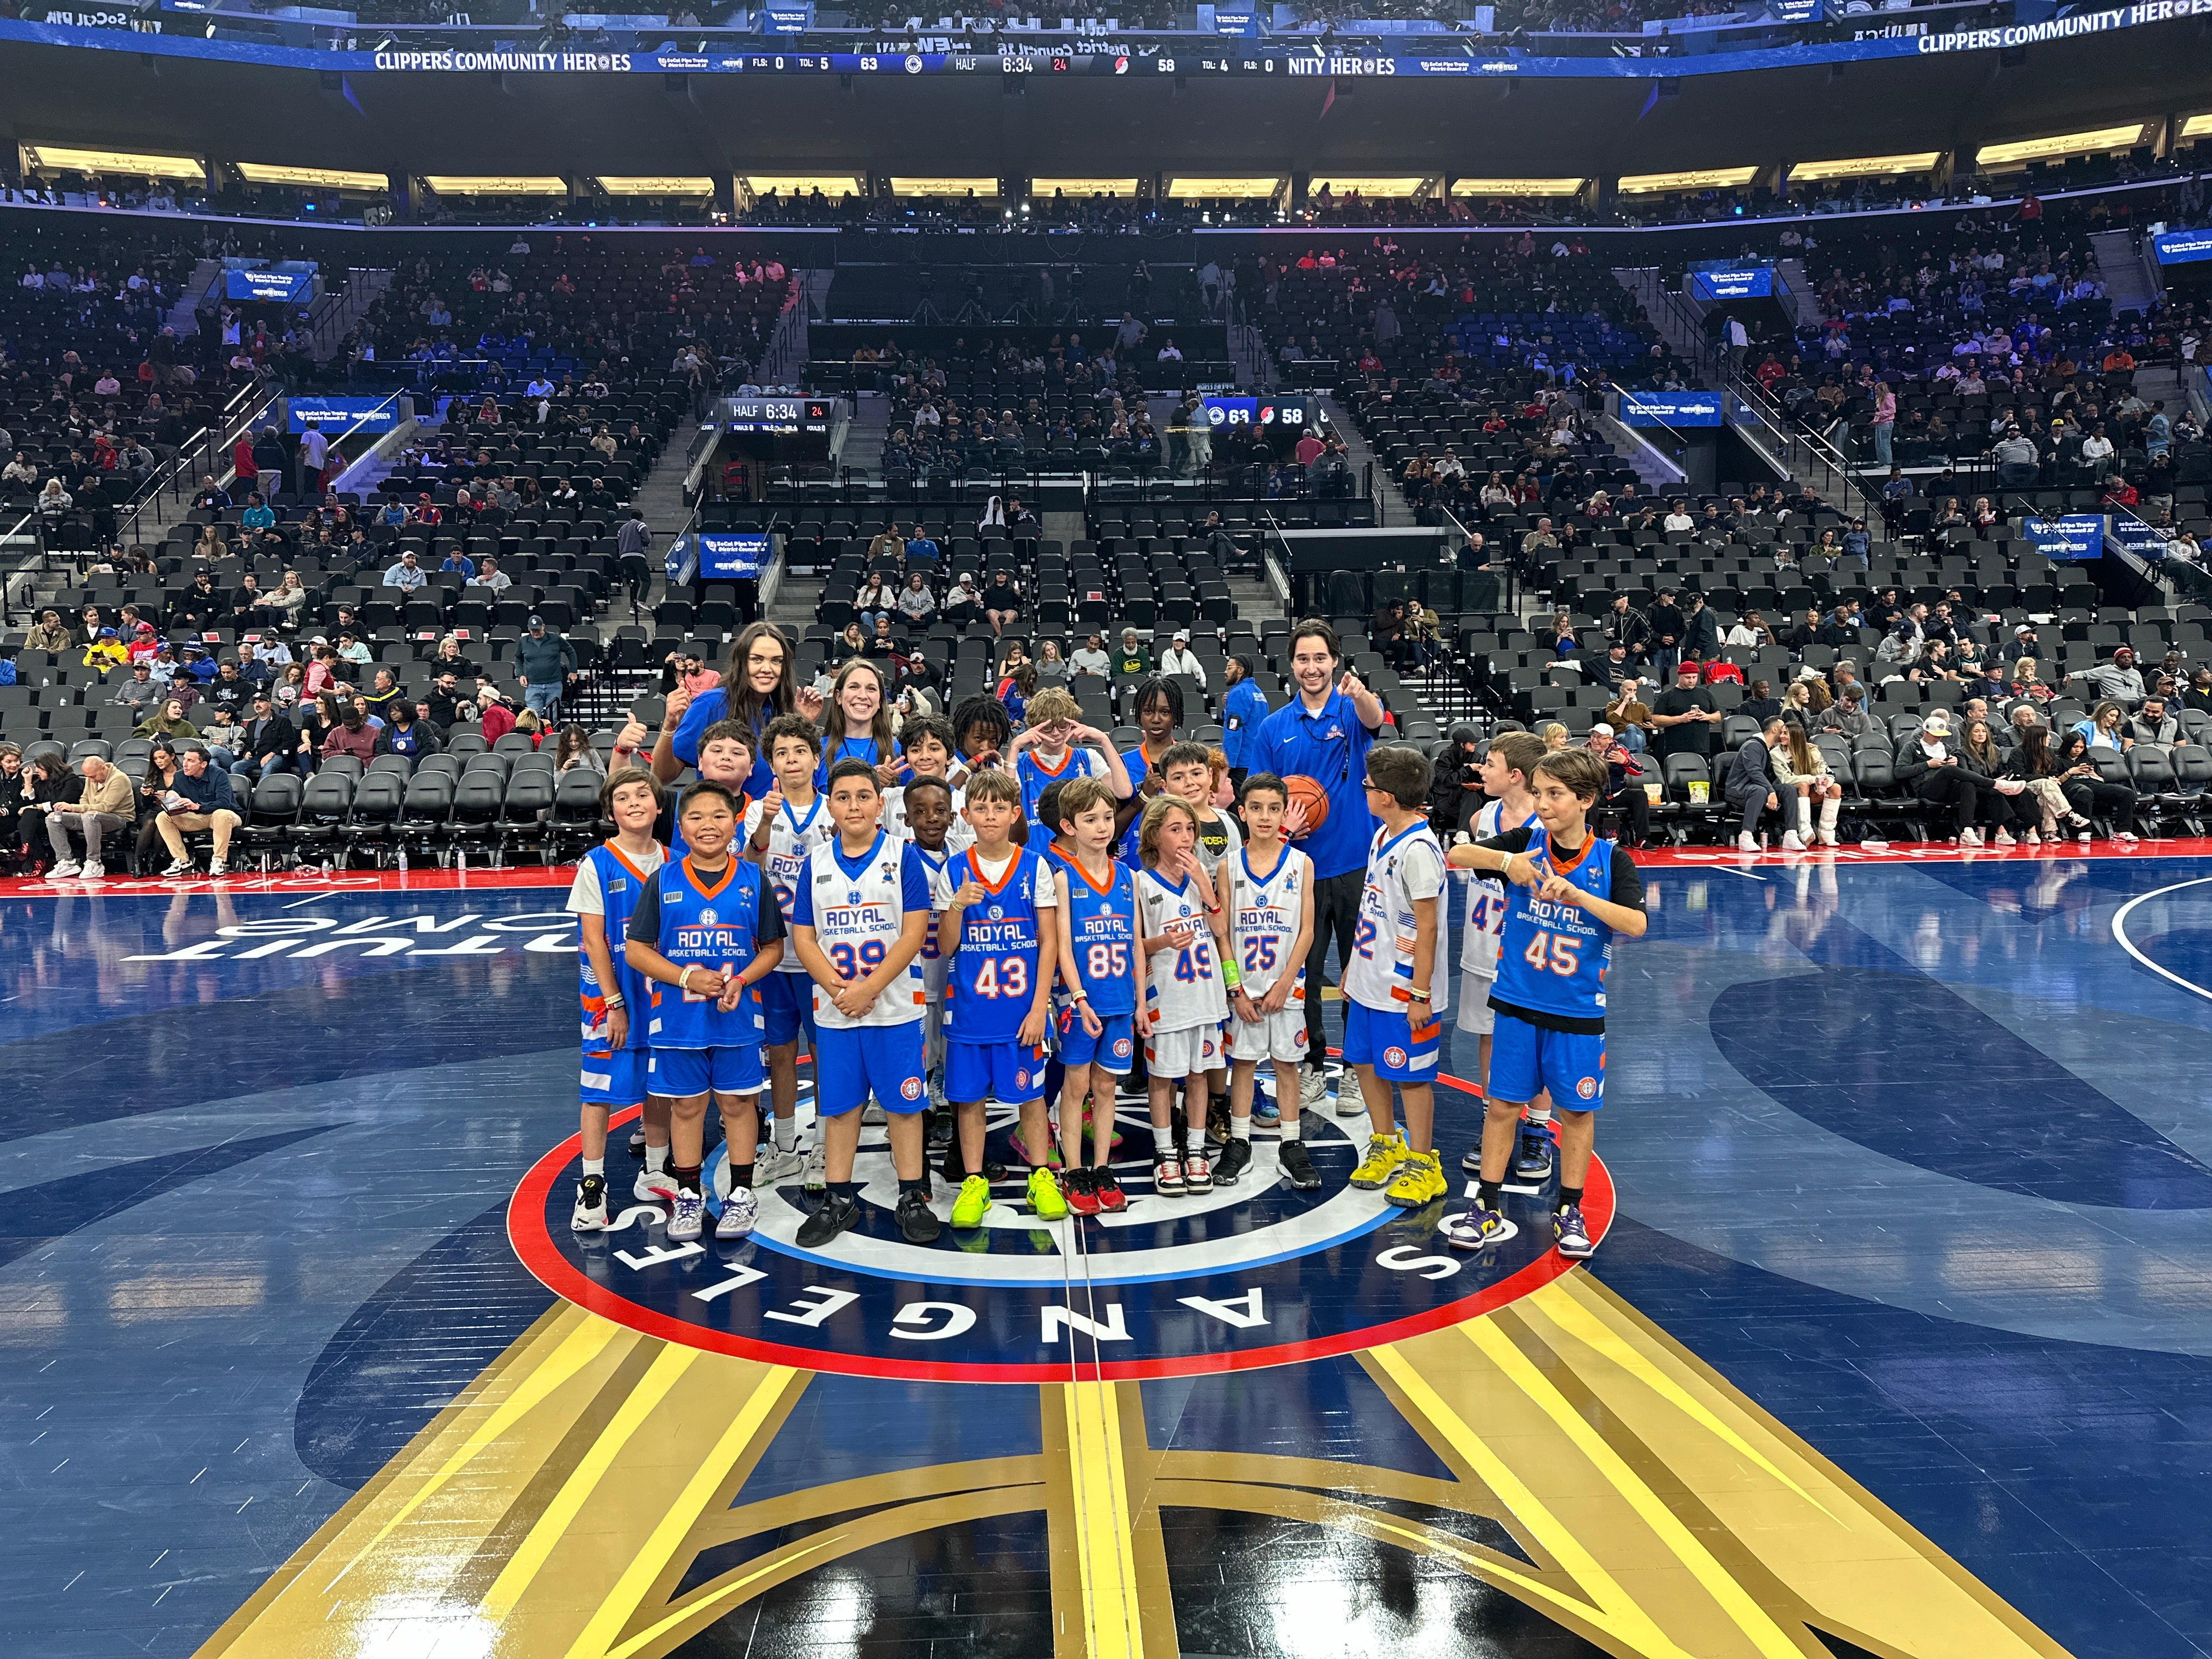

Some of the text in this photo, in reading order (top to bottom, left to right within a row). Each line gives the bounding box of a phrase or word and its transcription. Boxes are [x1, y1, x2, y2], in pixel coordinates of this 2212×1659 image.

[1918, 29, 2001, 53] CLIPPERS
[2004, 8, 2125, 46] COMMUNITY
[375, 52, 631, 71] CLIPPERS COMMUNITY HEROES
[753, 57, 877, 70] FLS: 0 TOL: 5 63
[955, 57, 1175, 73] HALF 6:34 24 58
[1202, 59, 1273, 72] TOL: 4 FLS: 0
[1288, 58, 1395, 75] NITY HEROES
[733, 404, 822, 419] HALF 6:34 24
[1229, 409, 1302, 424] 63 58
[771, 857, 803, 873] ROY
[826, 908, 886, 927] ROYAL
[1240, 911, 1283, 925] ROYAL
[1528, 899, 1584, 925] ROYAL
[823, 922, 897, 936] SKETBALL SCHOOL
[1085, 918, 1128, 934] ROYAL
[1268, 924, 1293, 933] SCHOOL
[1516, 911, 1598, 937] BASKETBALL SCHOOL
[678, 930, 738, 948] ROYAL
[968, 924, 1026, 942] ROYAL
[1074, 934, 1116, 943] BASKETBALL
[119, 933, 579, 961] TUIT
[668, 948, 748, 957] BASKETBALL SCHOOL
[960, 939, 1037, 952] BASKETBALL SCHOOL
[1244, 935, 1279, 972] 25
[1524, 930, 1582, 977] 45
[830, 939, 887, 981] 39
[1087, 942, 1128, 979] 85
[974, 956, 1028, 1000] 43
[599, 1204, 1272, 1343] ANGELES
